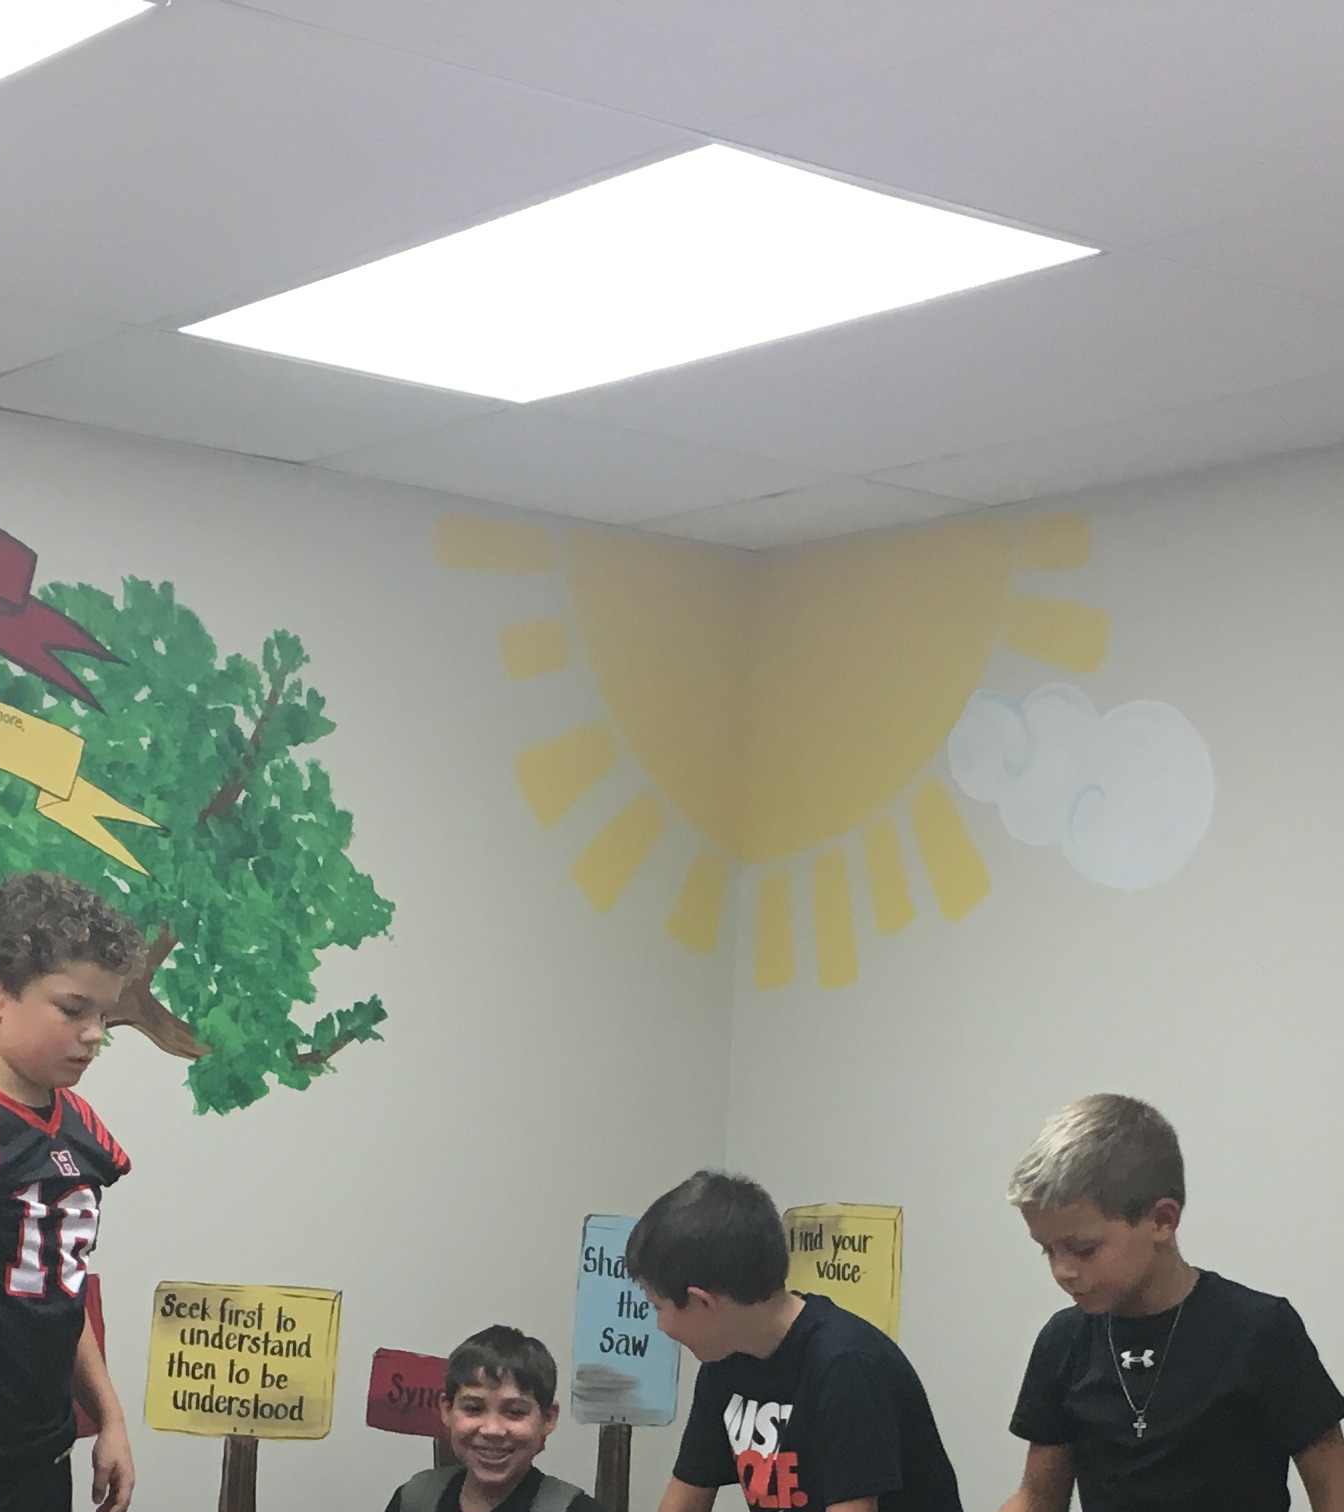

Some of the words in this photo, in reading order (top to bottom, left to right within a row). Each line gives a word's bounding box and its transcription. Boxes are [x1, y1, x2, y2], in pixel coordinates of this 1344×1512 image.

[582, 1245, 628, 1280] Sha
[831, 1234, 874, 1263] your
[815, 1258, 864, 1284] voice
[160, 1293, 213, 1322] Seek
[219, 1297, 266, 1331] first
[275, 1305, 297, 1334] to
[616, 1290, 650, 1321] the
[179, 1324, 313, 1359] understand
[166, 1350, 217, 1381] then
[228, 1358, 251, 1385] to
[260, 1362, 290, 1390] be
[172, 1383, 305, 1422] understood
